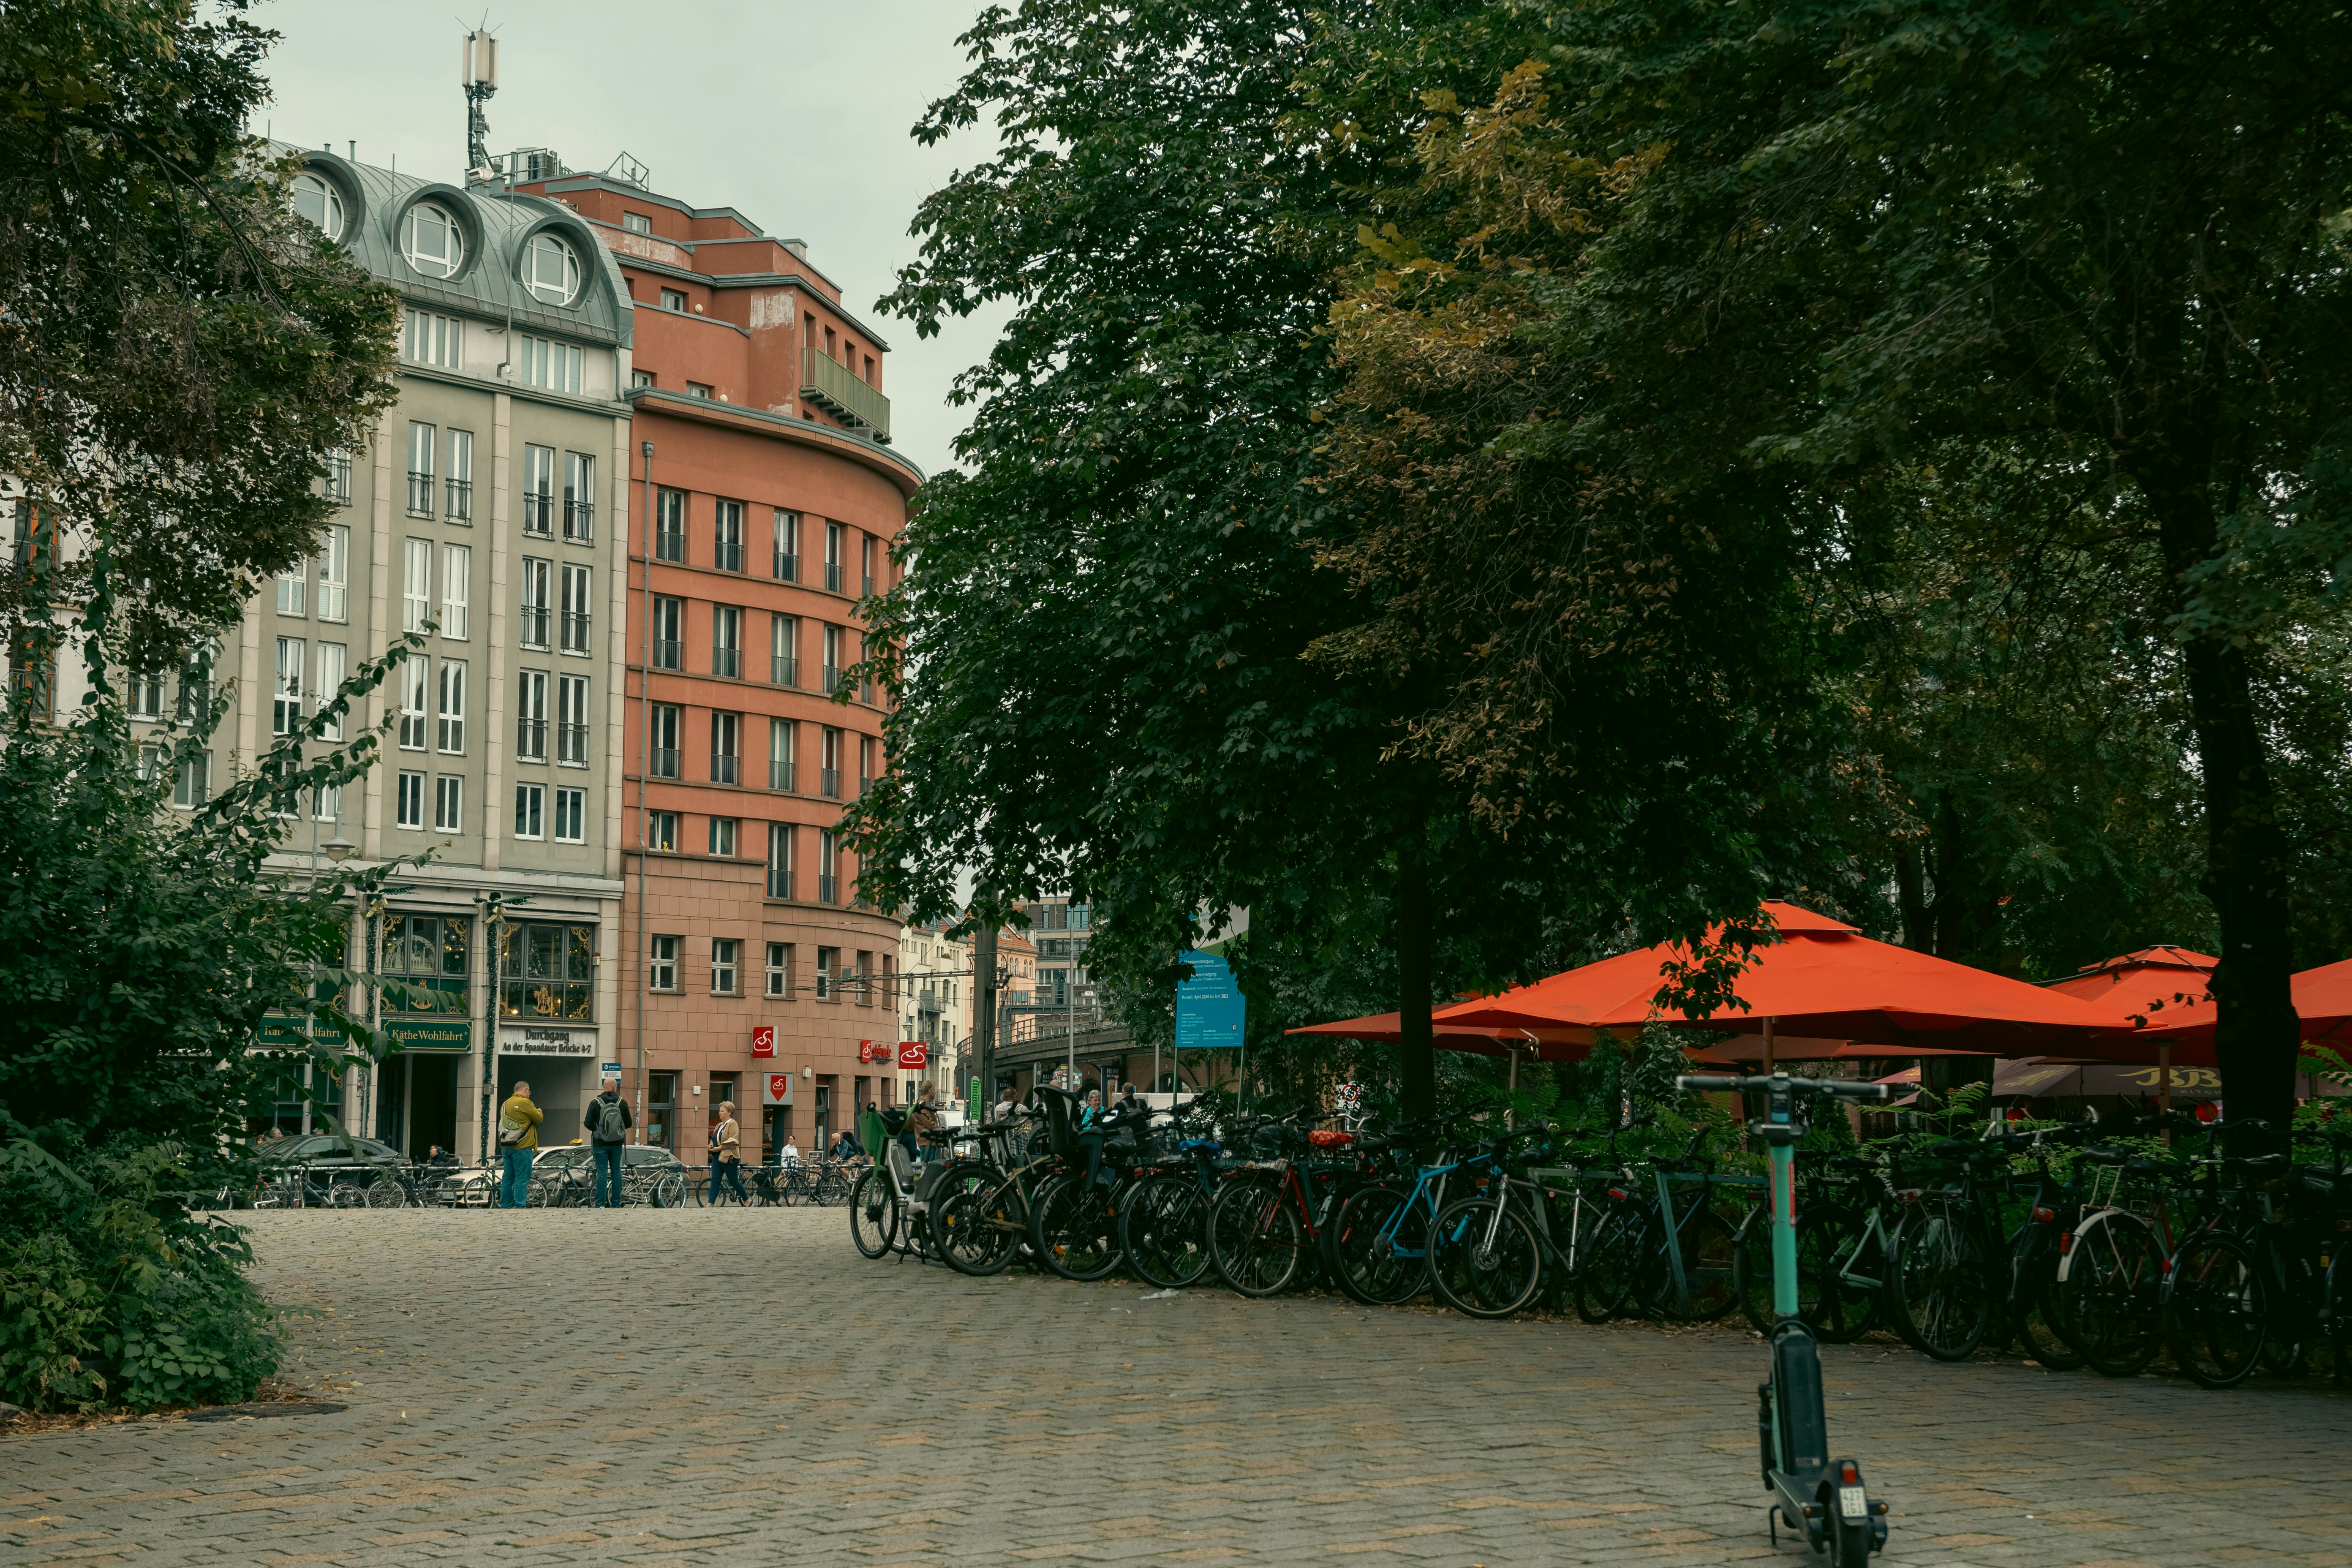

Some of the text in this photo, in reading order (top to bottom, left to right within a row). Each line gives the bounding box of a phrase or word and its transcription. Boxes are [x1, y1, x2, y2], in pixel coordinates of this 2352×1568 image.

[292, 1026, 340, 1037] Wolfahrt
[392, 1029, 418, 1040] Käthe
[525, 1029, 569, 1044] Durchgang
[503, 1042, 591, 1054] An der Spandauer Brücke 4-7
